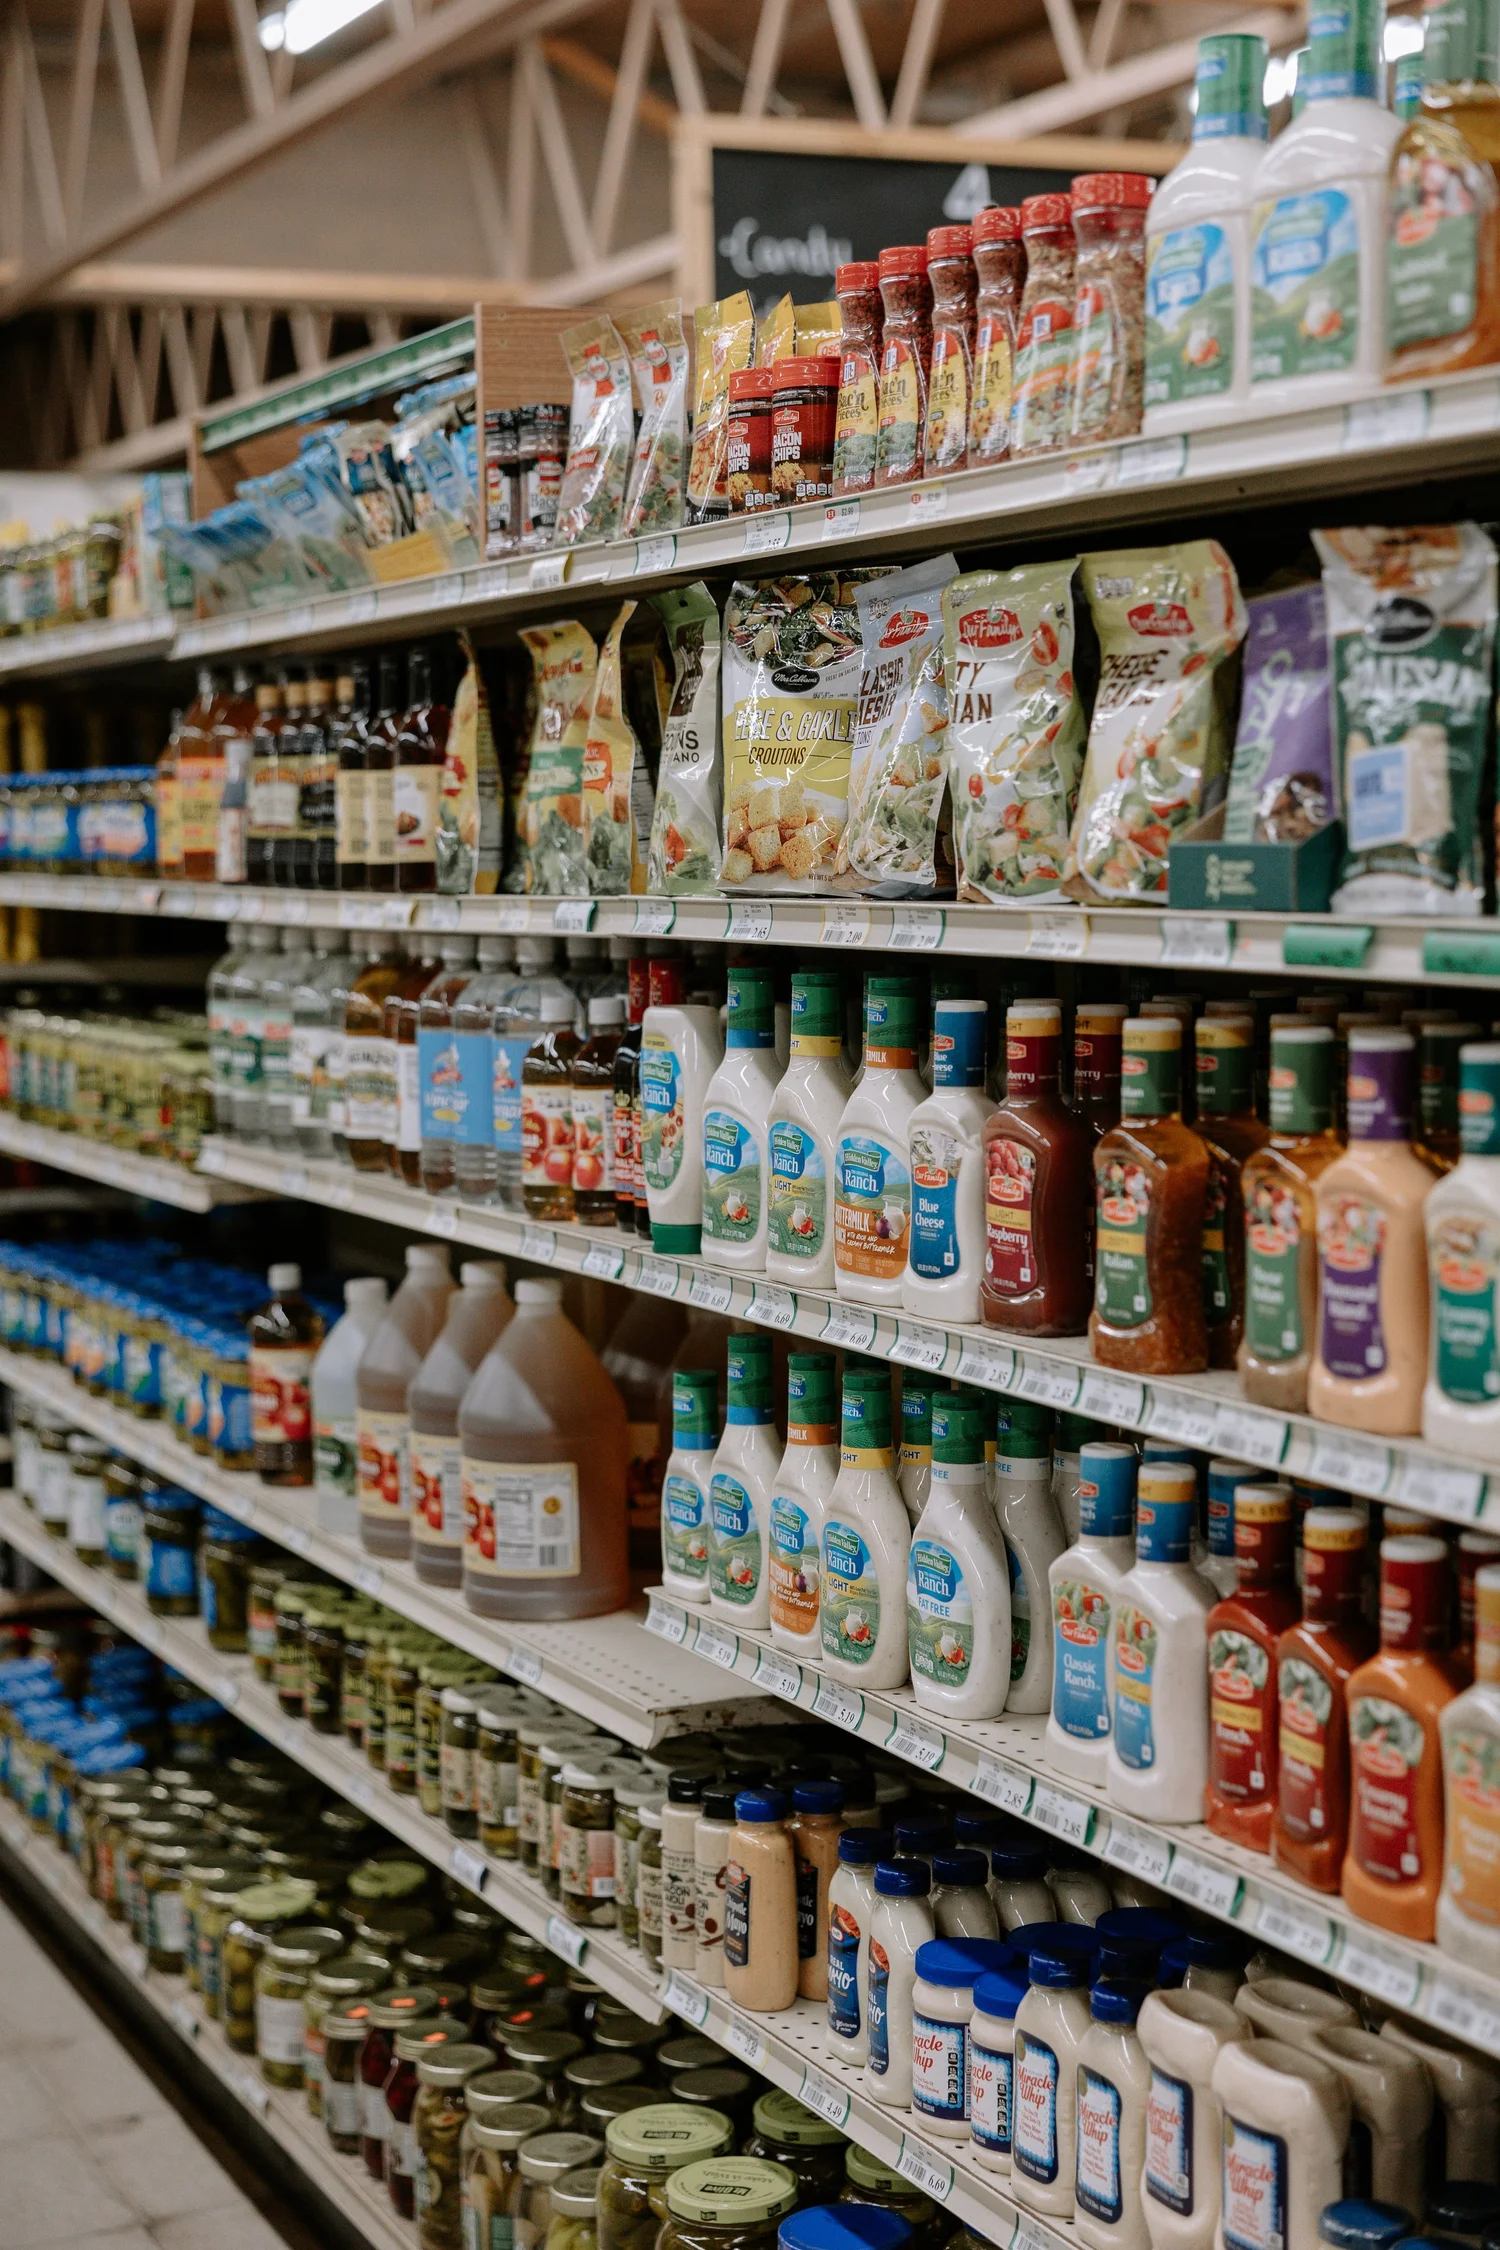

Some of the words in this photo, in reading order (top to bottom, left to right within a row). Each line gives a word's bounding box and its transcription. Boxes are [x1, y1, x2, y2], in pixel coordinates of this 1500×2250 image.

[773, 431, 802, 447] BACON
[774, 445, 801, 461] CHIPS
[857, 691, 898, 726] AESAR
[776, 710, 794, 742] &
[796, 709, 858, 744] GARLI
[856, 730, 873, 746] TONS
[749, 747, 807, 766] CROUTONS
[751, 927, 767, 940] 2.65
[845, 931, 863, 944] 2.09
[867, 1050, 887, 1063] ERMILK
[1007, 1069, 1036, 1084] berry
[924, 1169, 945, 1184] Family
[774, 1179, 792, 1193] LIGHT
[919, 1197, 939, 1214] Blue
[836, 1204, 870, 1233] UTTERMILK
[915, 1212, 945, 1230] Cheese
[986, 1222, 1029, 1250] Raspberry
[863, 1242, 896, 1255] BUTTERMILK
[711, 1294, 726, 1308] 6.69
[774, 1311, 791, 1326] 6.69
[849, 1330, 867, 1346] 6.69
[921, 1350, 940, 1366] 2.85
[788, 1426, 807, 1441] ERMILK
[843, 1453, 858, 1463] GHT
[917, 1553, 933, 1569] Hidden
[828, 1576, 849, 1593] LIGHT
[918, 1596, 930, 1609] FAT
[930, 1601, 951, 1618] FREE
[716, 1648, 732, 1663] 5.19
[1063, 1653, 1097, 1674] Classic
[779, 1679, 796, 1695] 5.19
[1064, 1669, 1096, 1690] Ranch
[838, 1709, 856, 1725] 5.19
[914, 1747, 936, 1764] 5.19
[1002, 1789, 1023, 1809] 2.85
[1062, 1817, 1083, 1838] 2.85
[726, 1910, 748, 1937] Mayo
[829, 1954, 845, 1971] REAL
[913, 2034, 943, 2052] racle
[971, 2064, 993, 2082] acle
[1017, 2064, 1055, 2090] Miracle
[1020, 2083, 1046, 2110] Whip
[826, 2101, 842, 2119] 4.49
[1079, 2100, 1118, 2127] Miracle
[1148, 2096, 1183, 2127] Miracle
[1082, 2119, 1109, 2147] Whip
[1149, 2118, 1175, 2149] Whip
[1226, 2150, 1276, 2184] Miracle
[926, 2172, 947, 2194] 6.69
[1229, 2173, 1265, 2207] Whip
